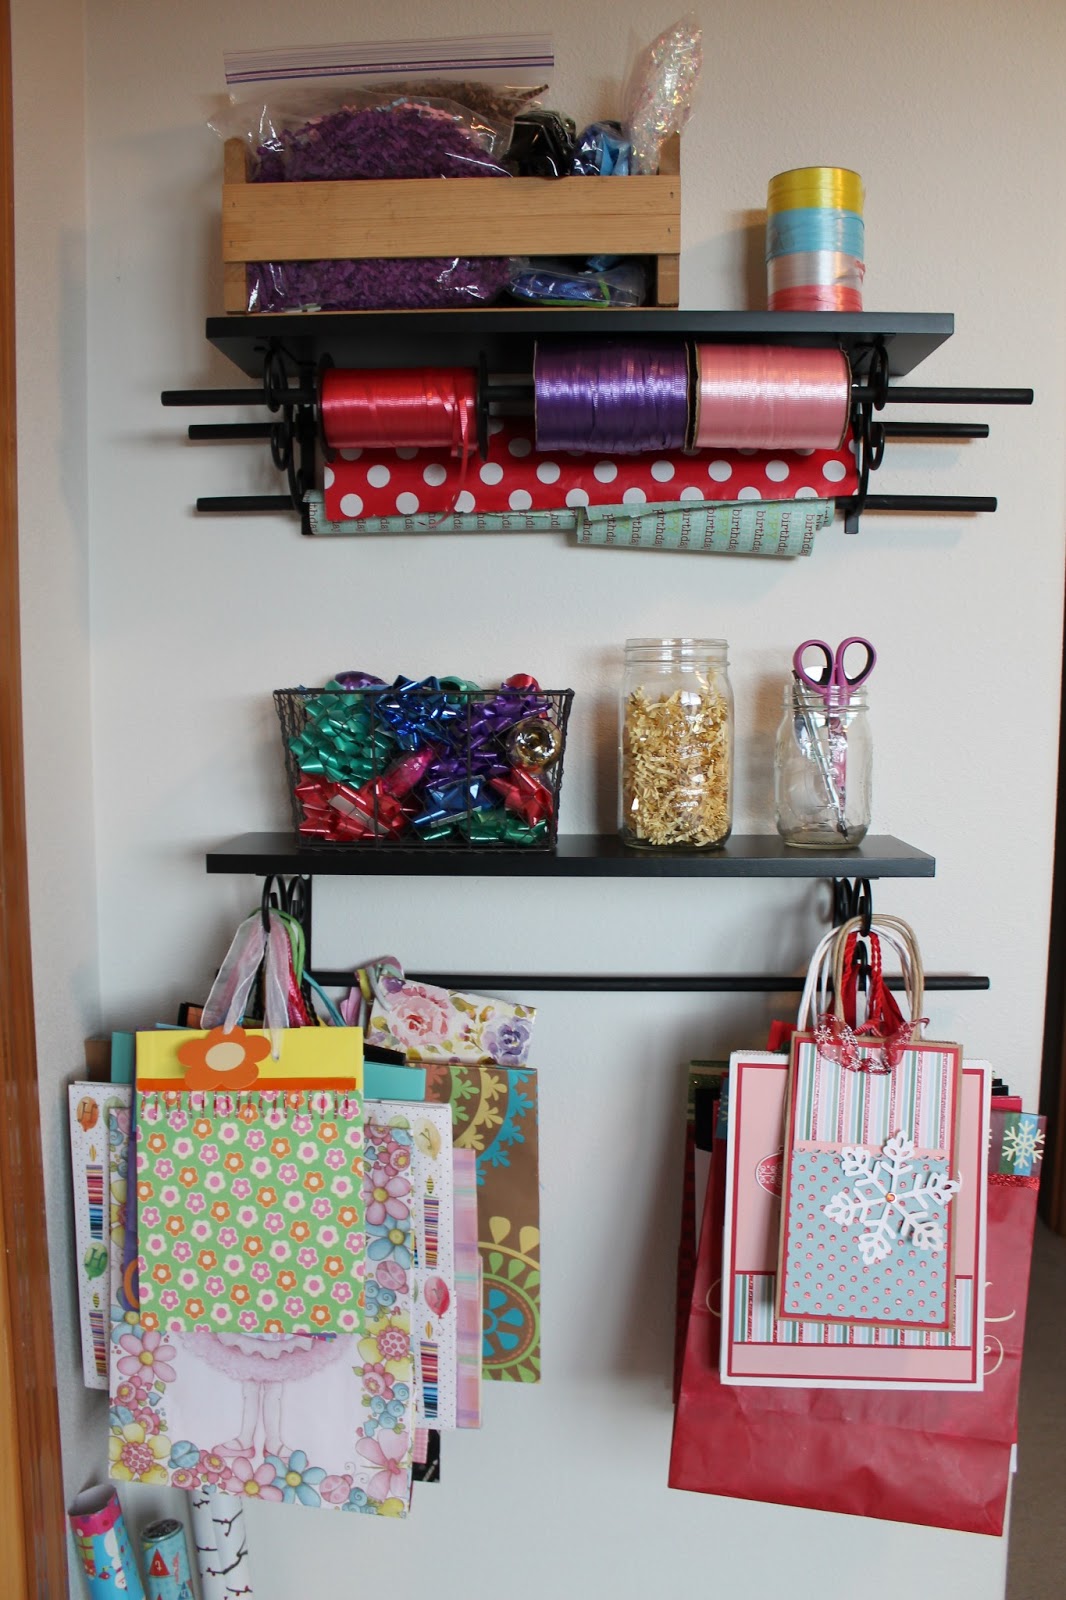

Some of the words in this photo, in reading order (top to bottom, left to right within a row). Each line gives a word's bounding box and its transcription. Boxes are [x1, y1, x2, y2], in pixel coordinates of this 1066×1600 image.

[629, 517, 642, 546] rthda
[77, 1101, 98, 1122] H
[84, 1247, 108, 1269] H
